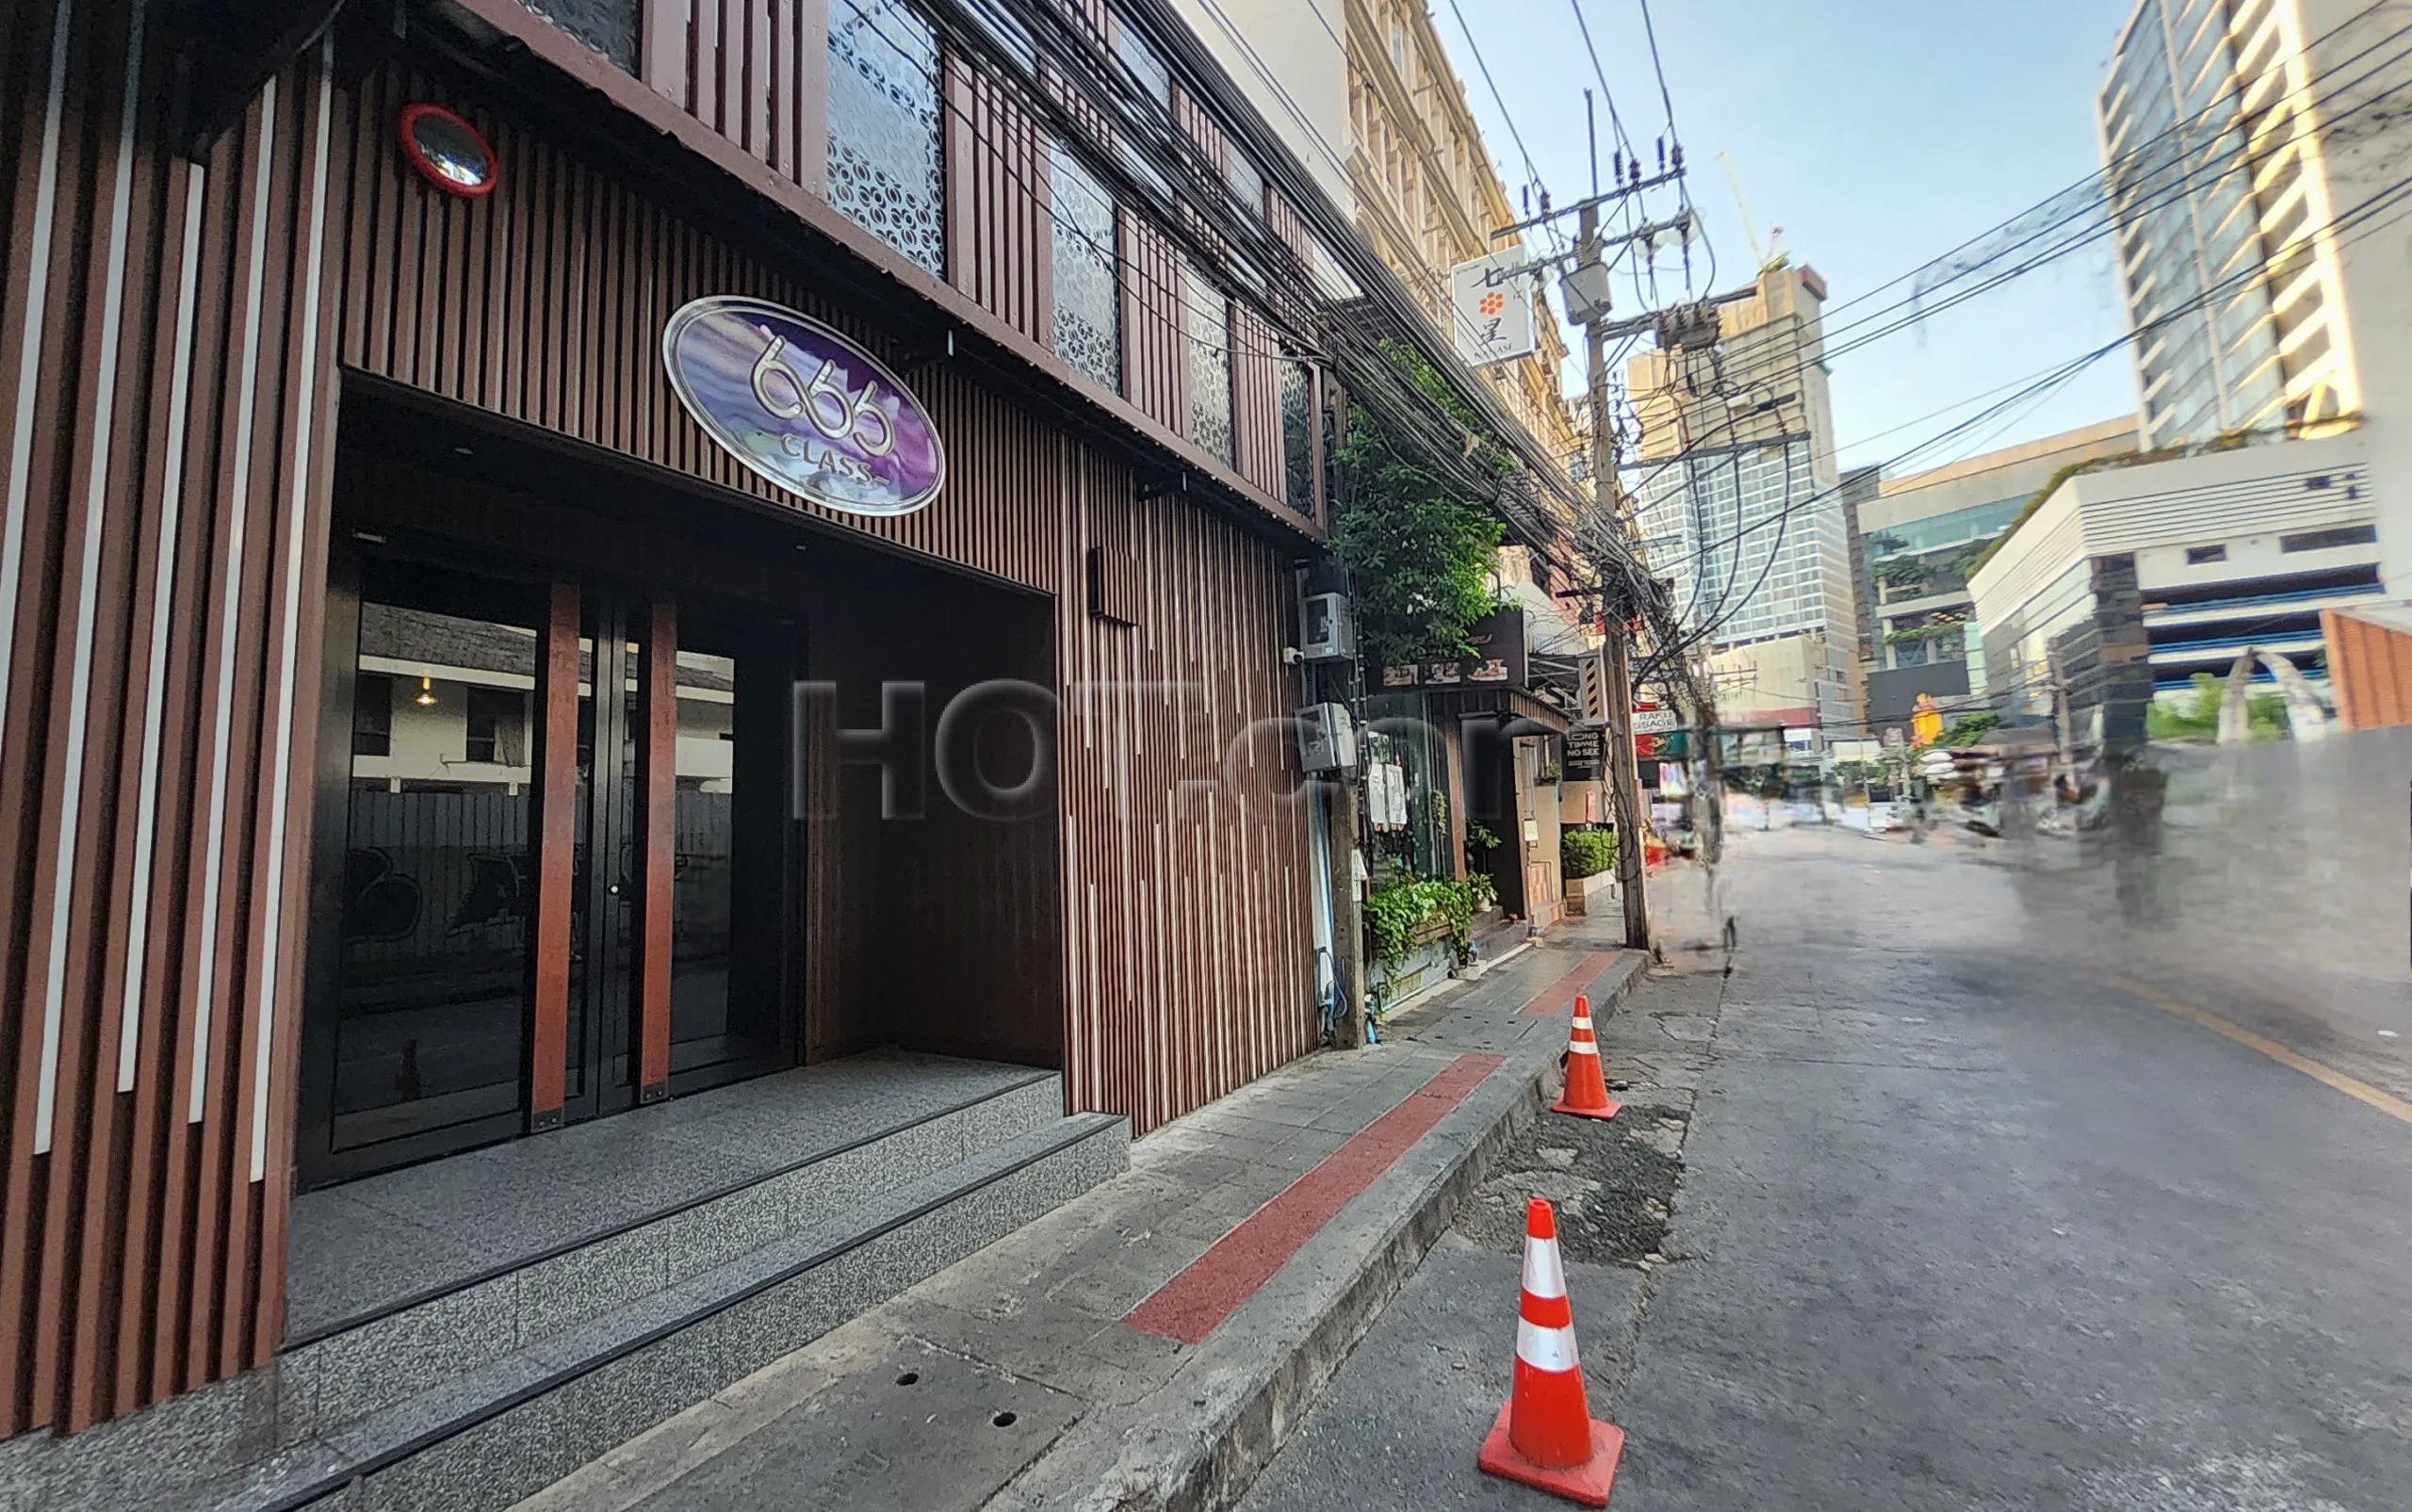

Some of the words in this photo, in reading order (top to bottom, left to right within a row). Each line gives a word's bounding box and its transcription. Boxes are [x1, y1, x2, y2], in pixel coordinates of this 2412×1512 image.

[779, 433, 872, 486] CLASS
[1566, 732, 1599, 741] LONG
[1566, 749, 1581, 757] NO
[1582, 748, 1600, 756] SEE
